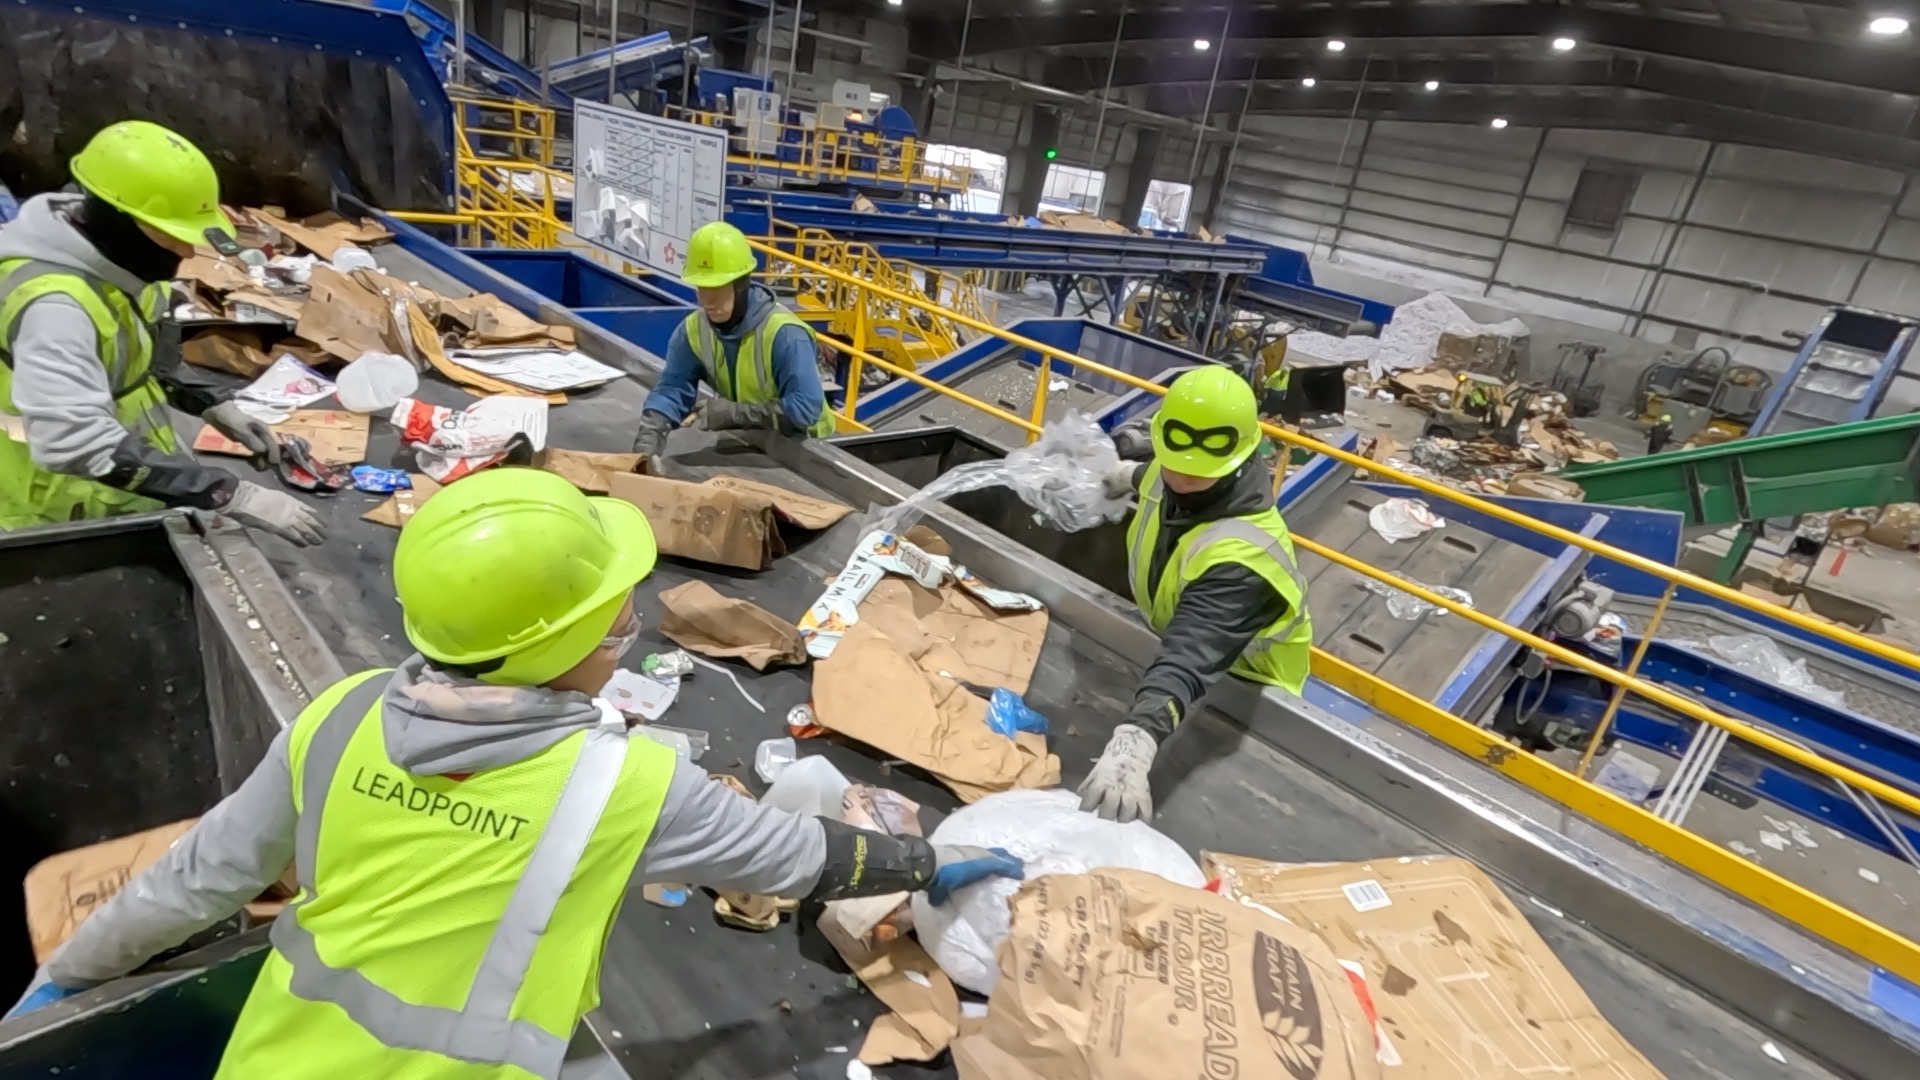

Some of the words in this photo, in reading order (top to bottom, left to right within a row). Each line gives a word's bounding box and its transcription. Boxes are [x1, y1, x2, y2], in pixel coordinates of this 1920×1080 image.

[817, 586, 847, 611] MIX
[841, 550, 875, 582] TRAIL
[352, 767, 530, 841] LEADPOINT
[1173, 908, 1198, 1012] FLOUR
[1262, 934, 1286, 1006] CRAFT
[1280, 943, 1304, 1011] GRAIN
